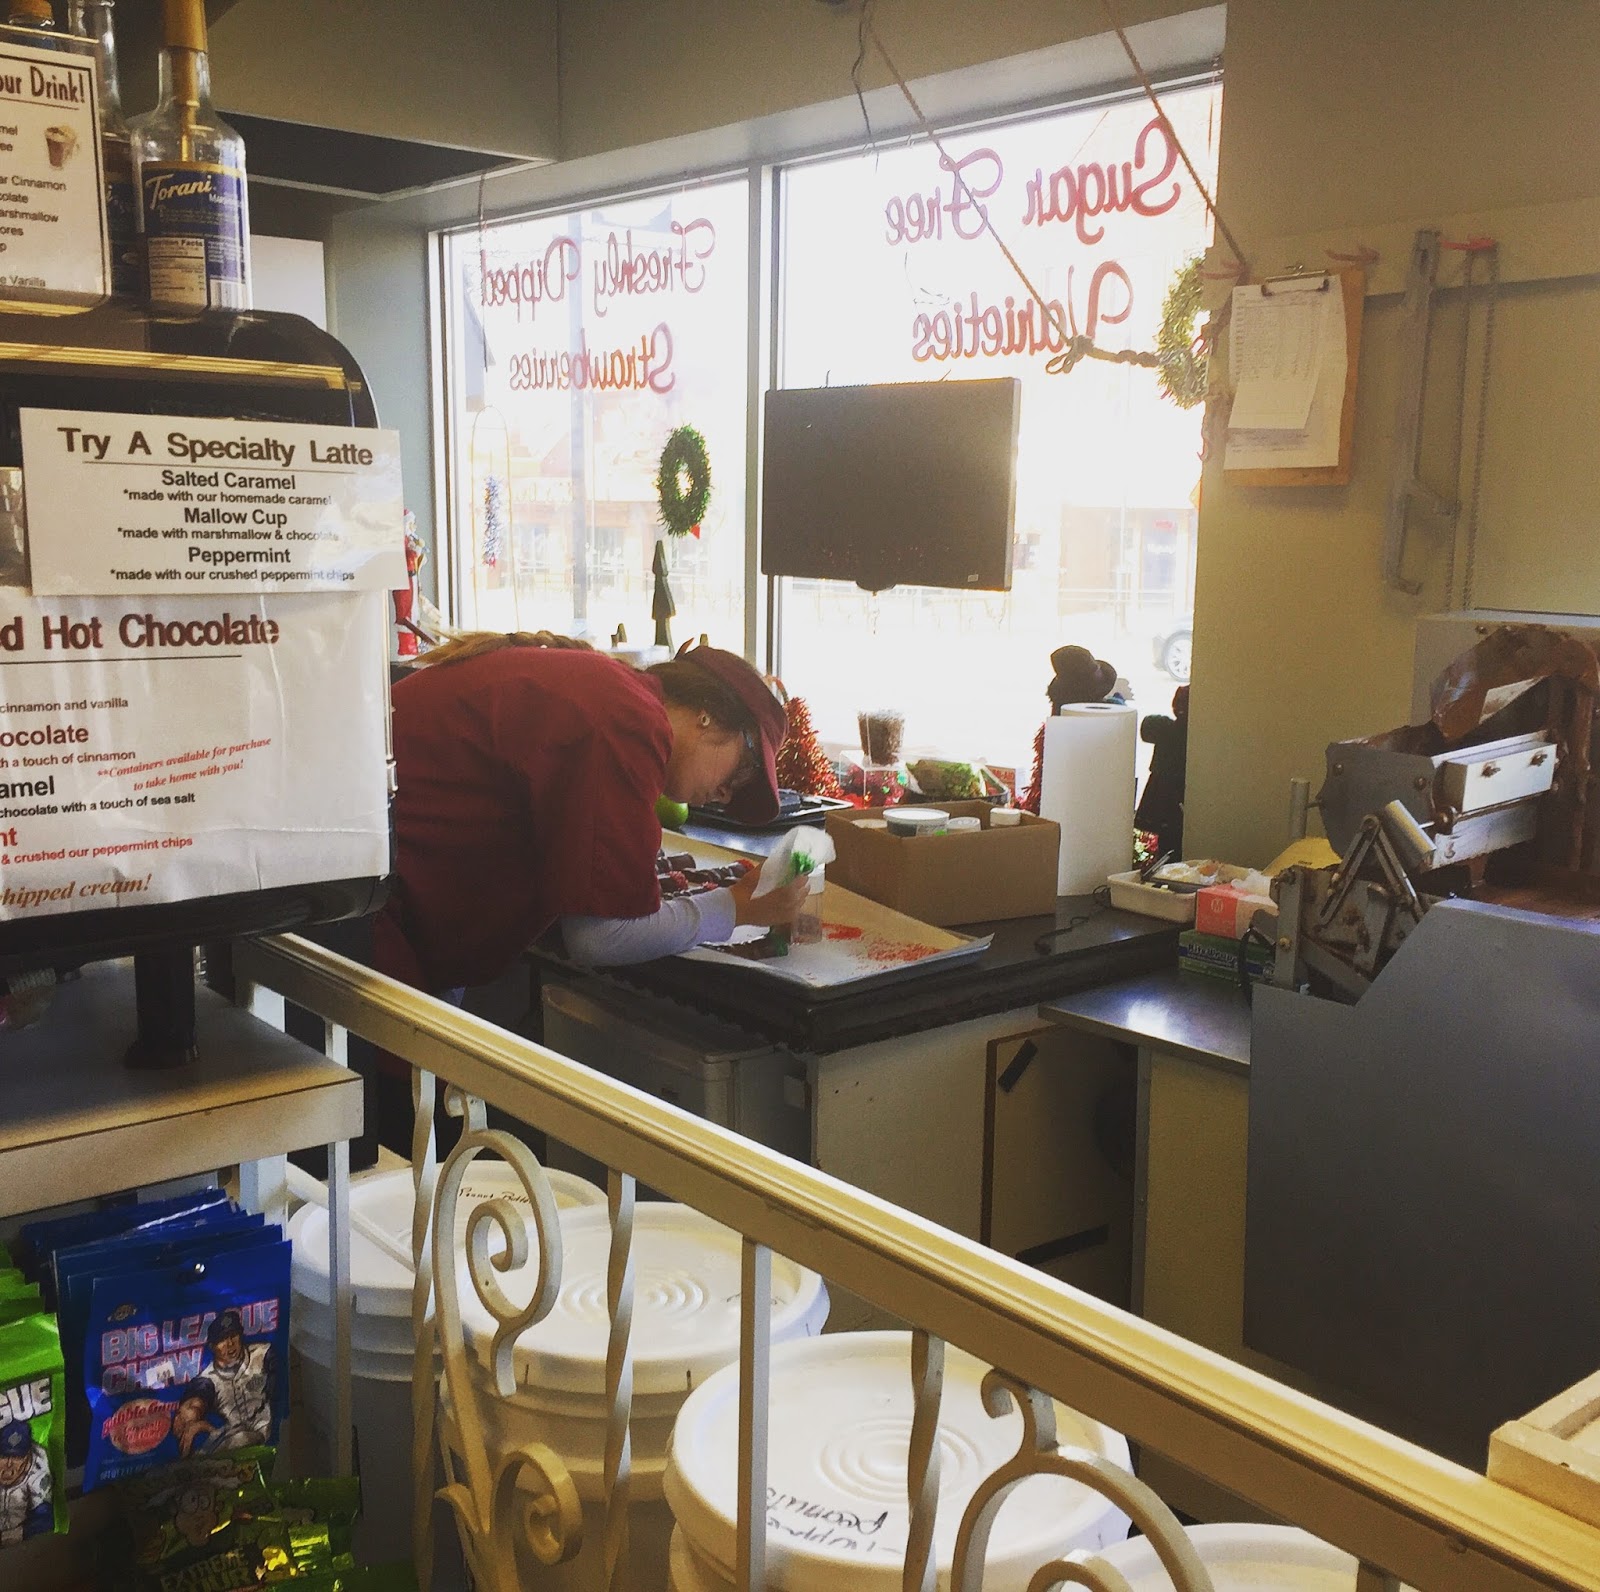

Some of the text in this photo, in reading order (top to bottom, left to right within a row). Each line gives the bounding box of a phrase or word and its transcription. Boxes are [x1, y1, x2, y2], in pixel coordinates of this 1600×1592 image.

[30, 65, 85, 103] Drink!
[11, 175, 67, 191] Cinnamon
[145, 173, 212, 210] Torani
[9, 275, 46, 287] Vanilla
[58, 427, 373, 467] Try A Specialty Latte
[162, 470, 296, 490] Salted Caramel
[168, 490, 193, 501] with
[197, 494, 217, 502] our
[220, 492, 286, 504] homemade
[185, 508, 287, 528] Mallow Cup
[162, 528, 188, 539] with
[191, 529, 272, 540] marshmallow
[275, 529, 283, 540] &
[286, 530, 339, 541] chocoe
[189, 547, 291, 566] Peppermint
[157, 569, 182, 580] with
[186, 573, 205, 581] our
[209, 569, 257, 580] crushed
[261, 570, 324, 582] peppermint
[0, 613, 279, 651] d Hot Chocolate
[0, 698, 129, 714] cinnamon and vanilla
[0, 724, 89, 747] ocolate
[12, 759, 19, 767] a
[23, 754, 58, 767] touch
[62, 753, 74, 765] of
[77, 751, 136, 763] cinnamon
[166, 751, 210, 767] available
[211, 747, 227, 760] for
[228, 737, 272, 756] purchase
[133, 759, 244, 791] to take home with you!
[61, 800, 87, 813] with
[90, 803, 97, 811] a
[100, 798, 133, 810] touch
[136, 796, 149, 807] of
[151, 797, 171, 806] sea
[174, 793, 195, 804] salt
[1, 837, 193, 865] & crushed our peppermint chips
[0, 873, 152, 909] hipped cream!
[102, 1299, 278, 1365] BIG LEAUE
[102, 1347, 203, 1395] CHW
